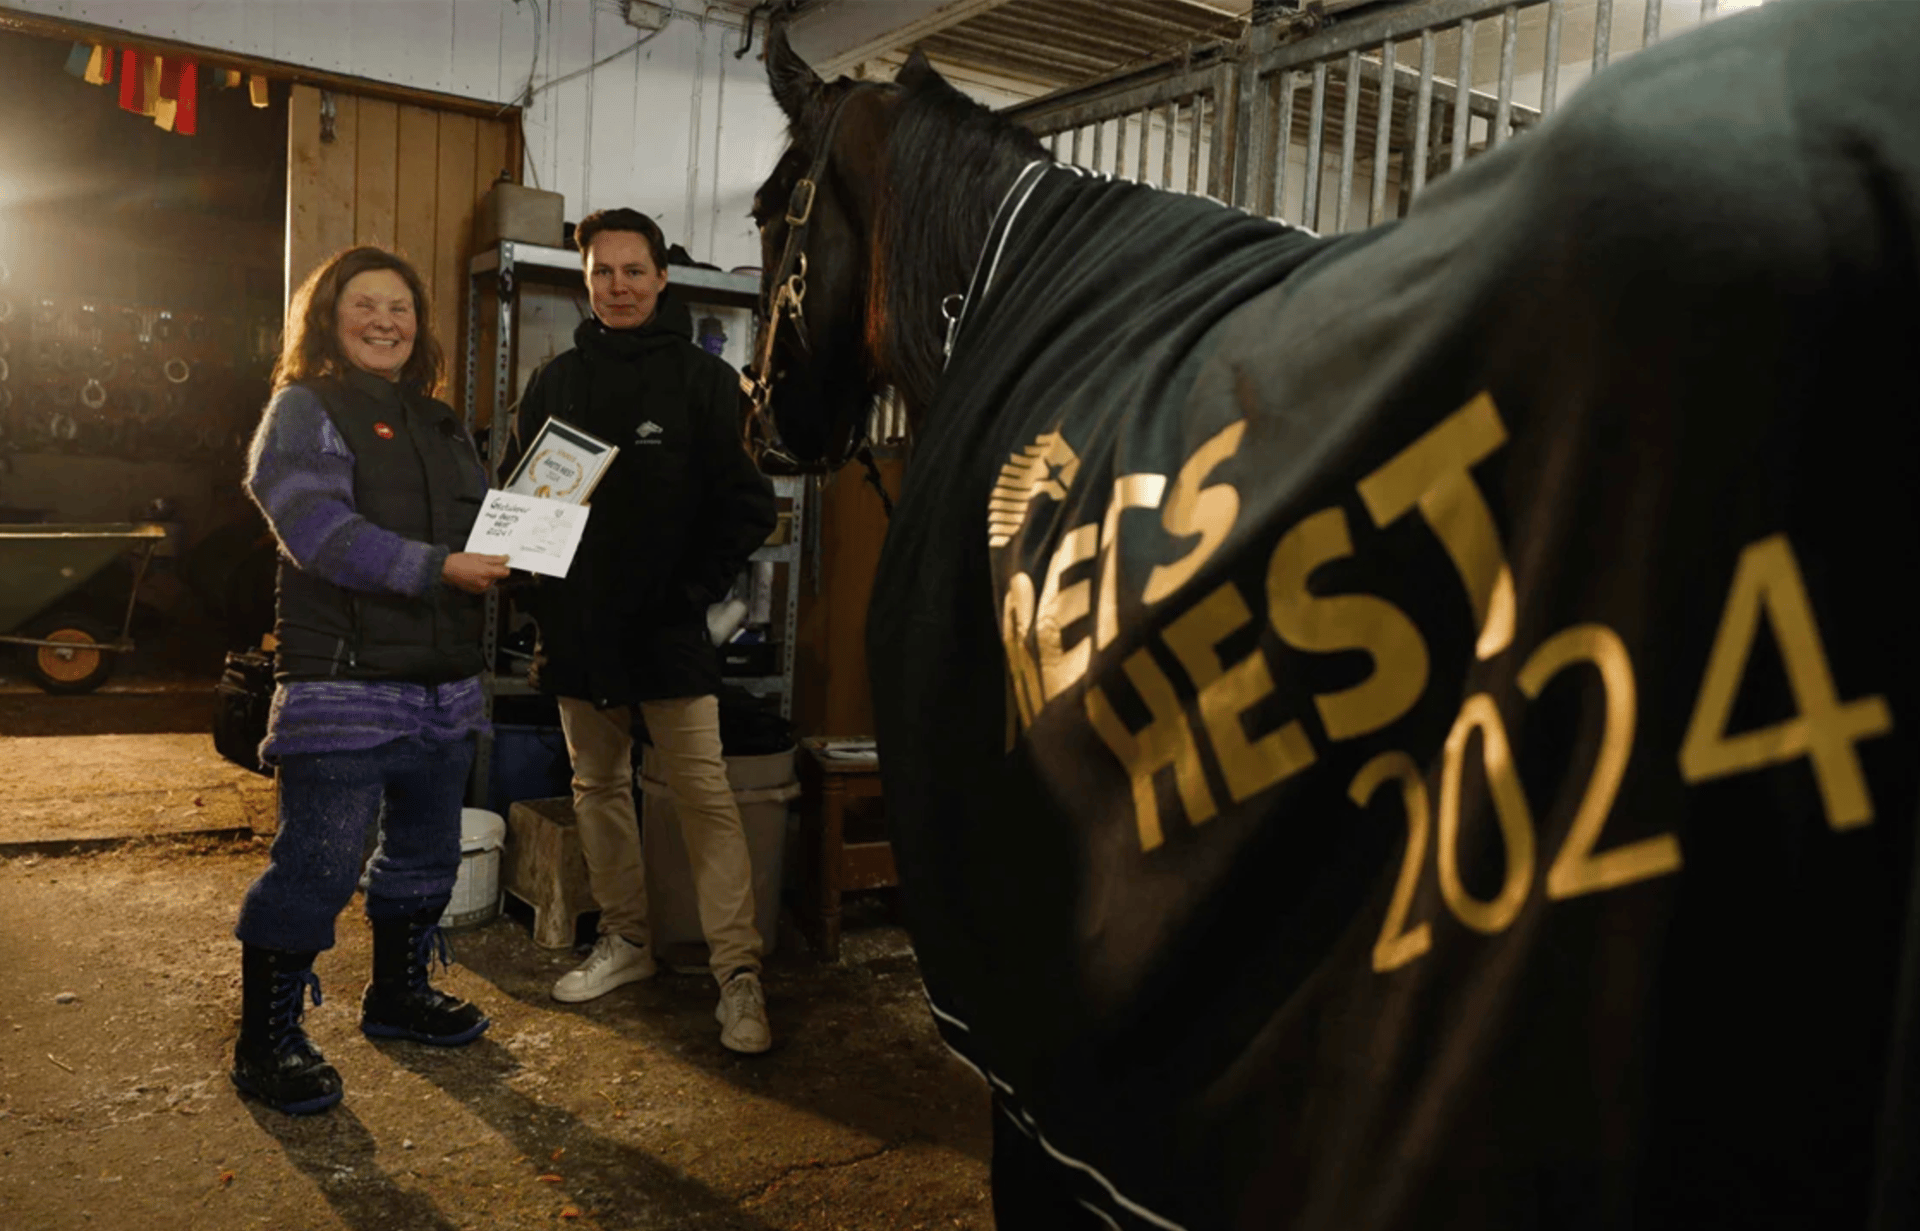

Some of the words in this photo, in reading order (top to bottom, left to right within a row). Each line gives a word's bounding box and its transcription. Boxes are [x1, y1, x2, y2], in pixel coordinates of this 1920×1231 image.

[1002, 418, 1248, 755] RETS
[1085, 390, 1516, 852] HEST
[1346, 531, 1894, 974] 2024
